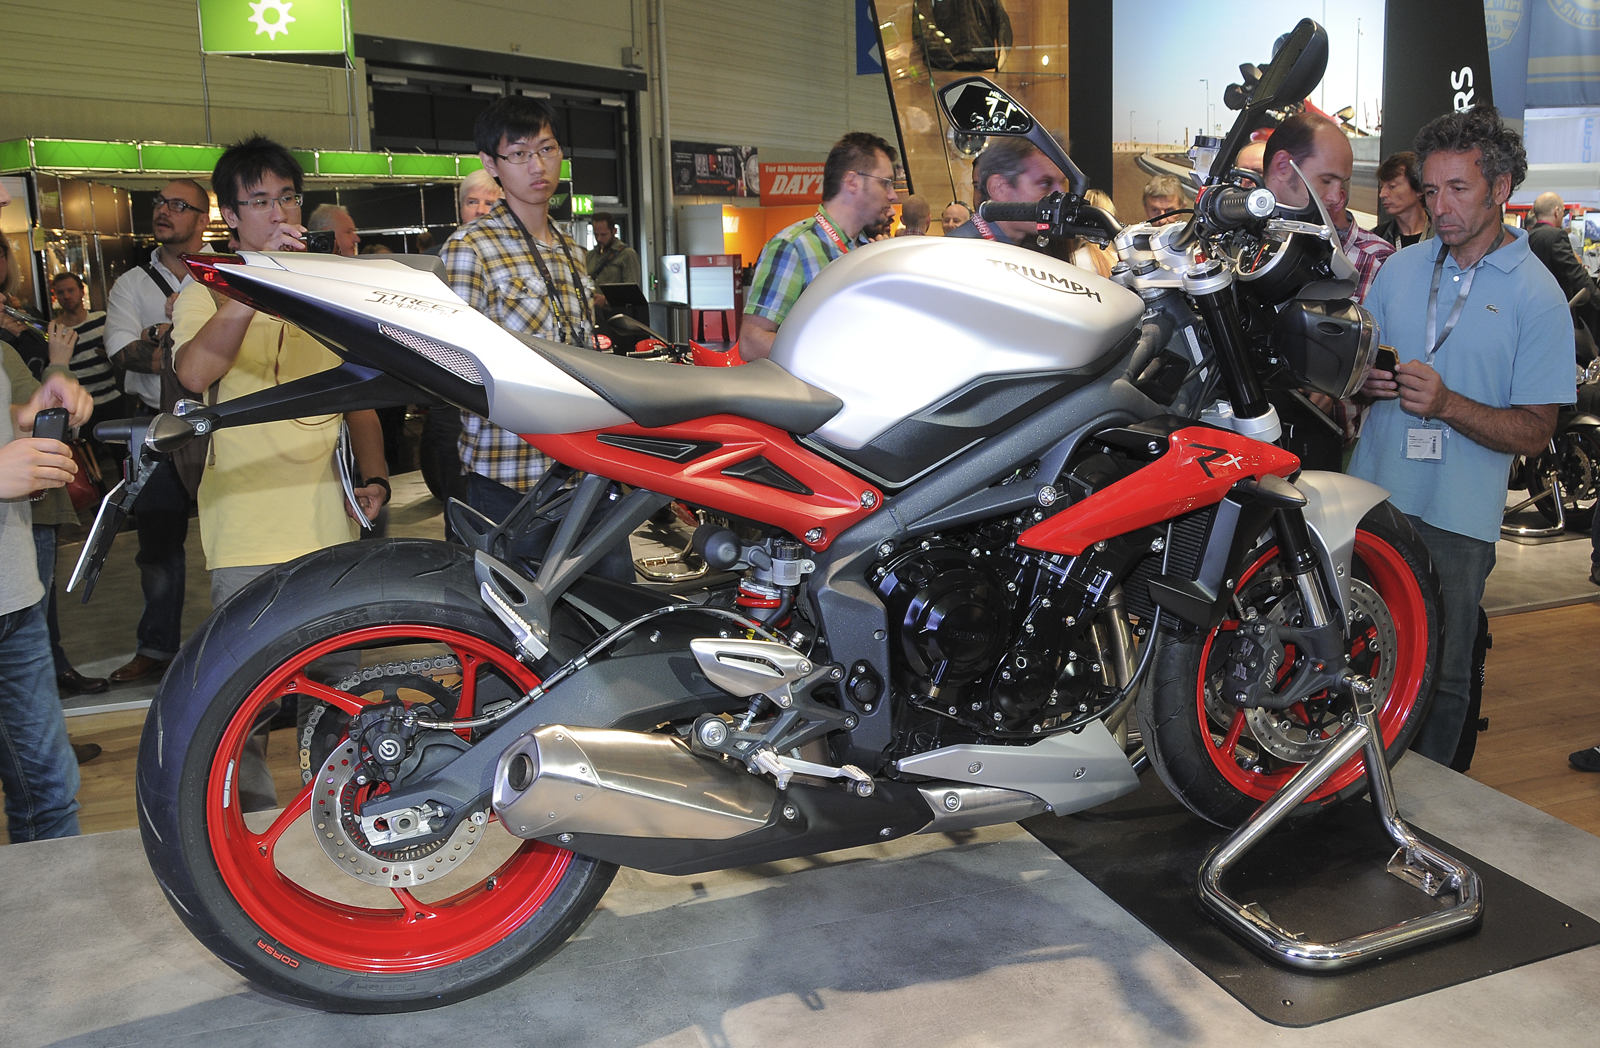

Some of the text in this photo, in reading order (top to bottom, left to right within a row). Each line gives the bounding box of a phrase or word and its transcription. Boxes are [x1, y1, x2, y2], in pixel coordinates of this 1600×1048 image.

[765, 165, 776, 173] For
[777, 165, 787, 173] All
[986, 258, 1102, 304] TRIUMPH
[364, 290, 464, 315] STREET
[257, 939, 300, 969] CORSA
